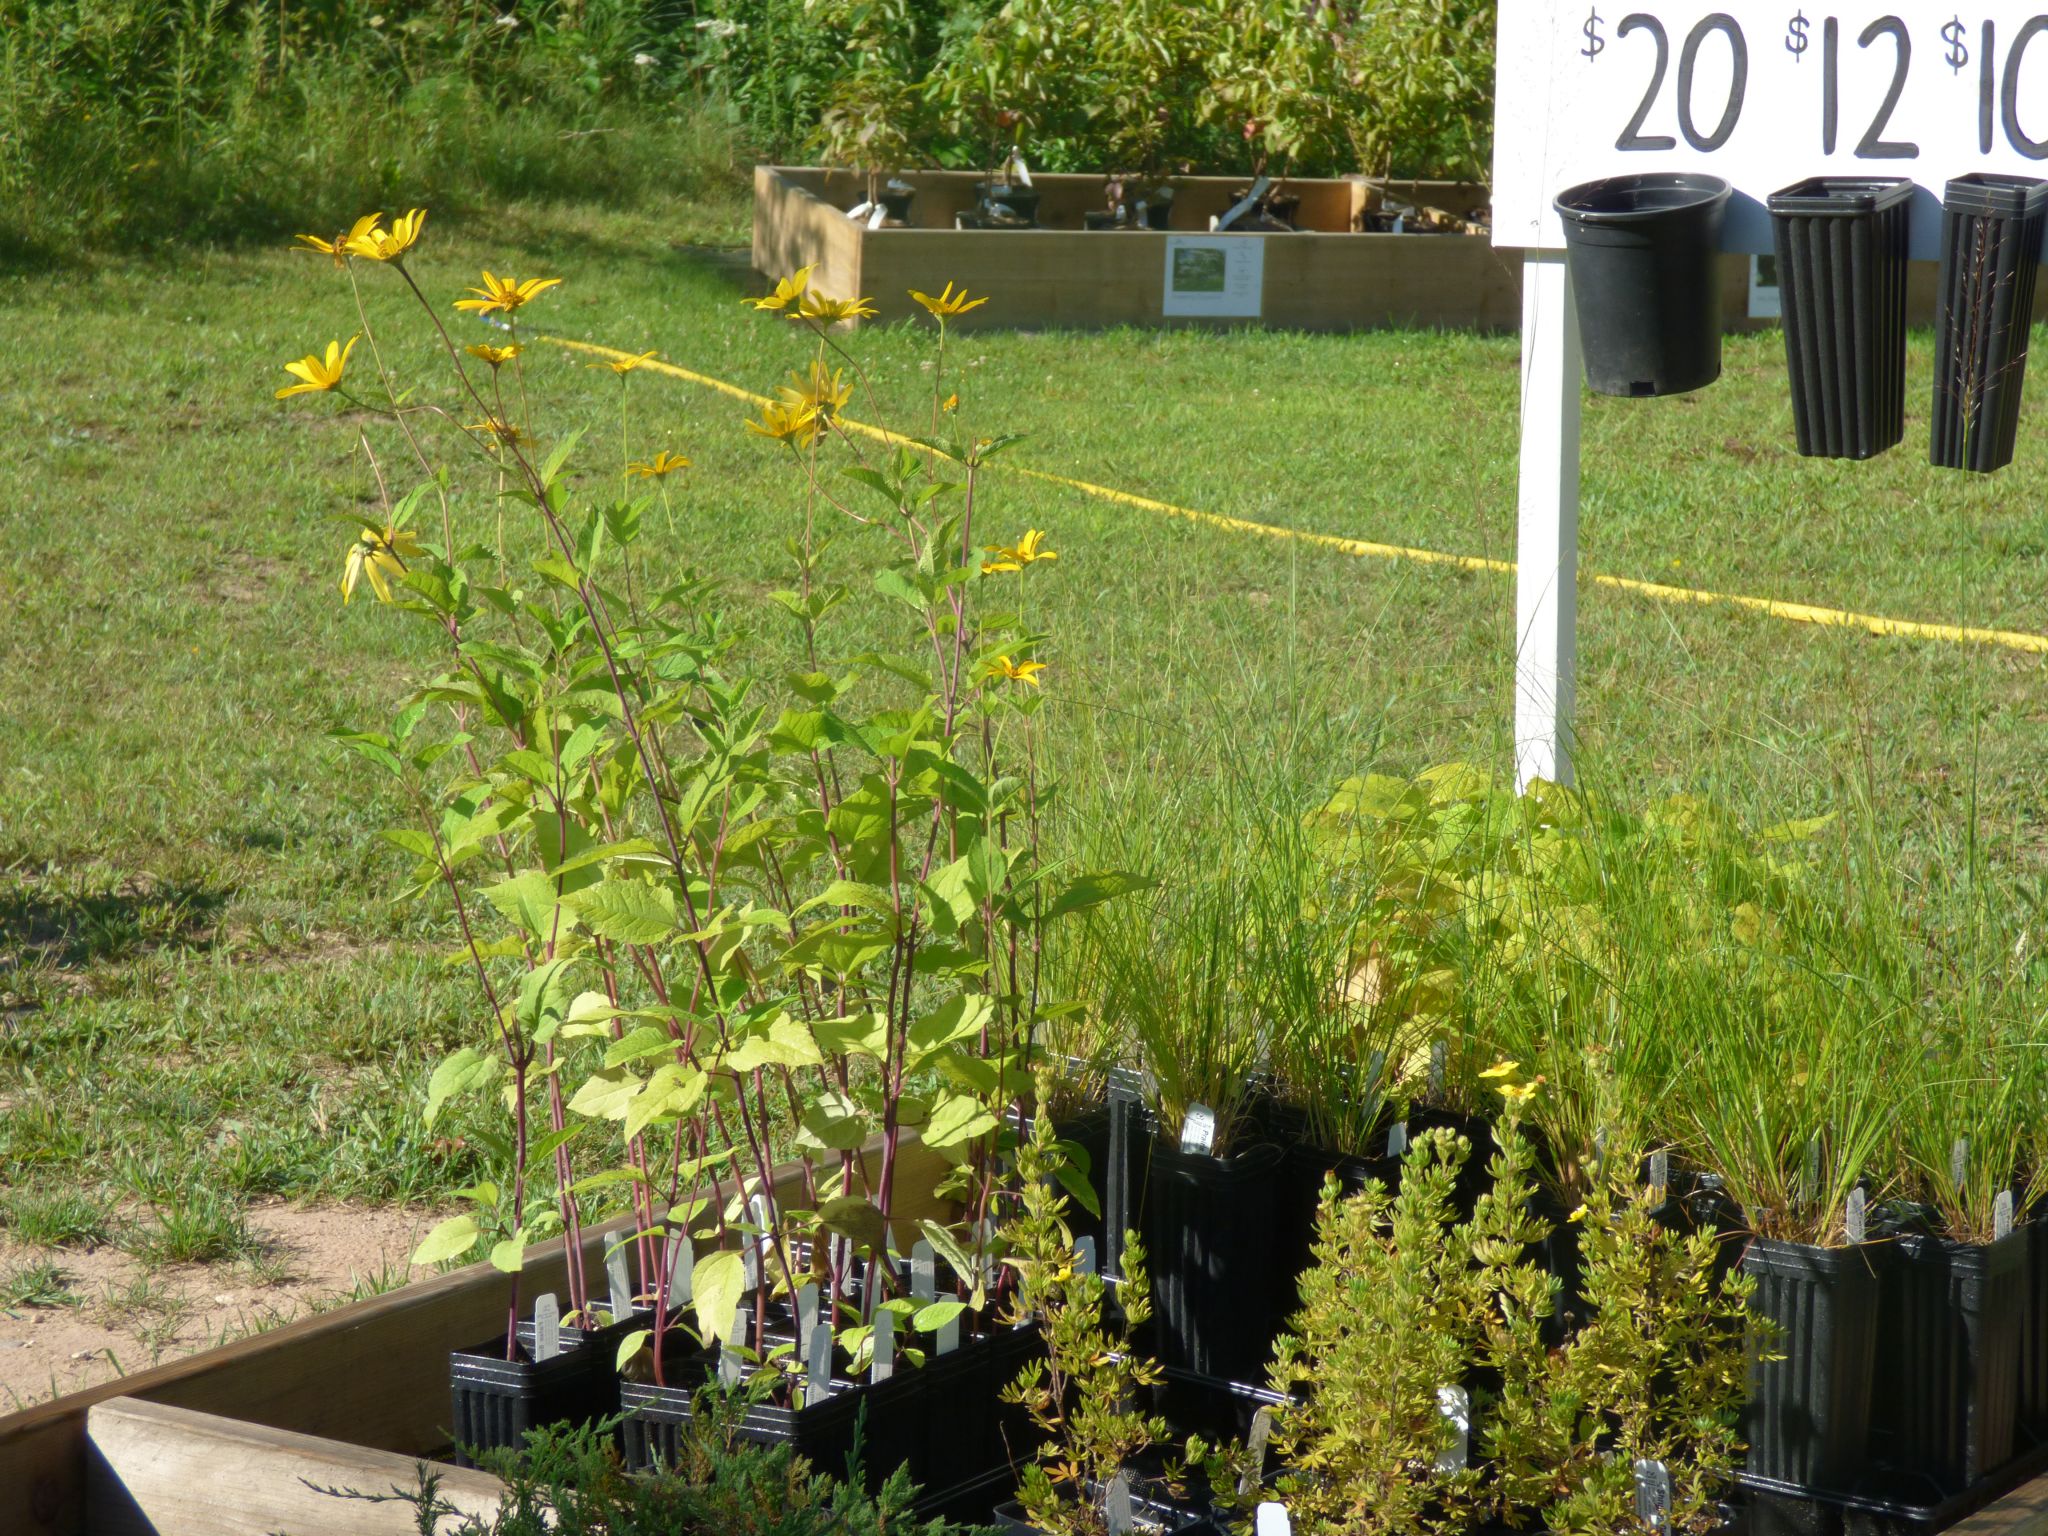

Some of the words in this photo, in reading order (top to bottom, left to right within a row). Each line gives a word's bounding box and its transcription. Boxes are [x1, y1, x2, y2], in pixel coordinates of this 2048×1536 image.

[1581, 5, 1748, 153] $20
[1785, 8, 1920, 160] $12
[1941, 13, 2048, 161] $10
